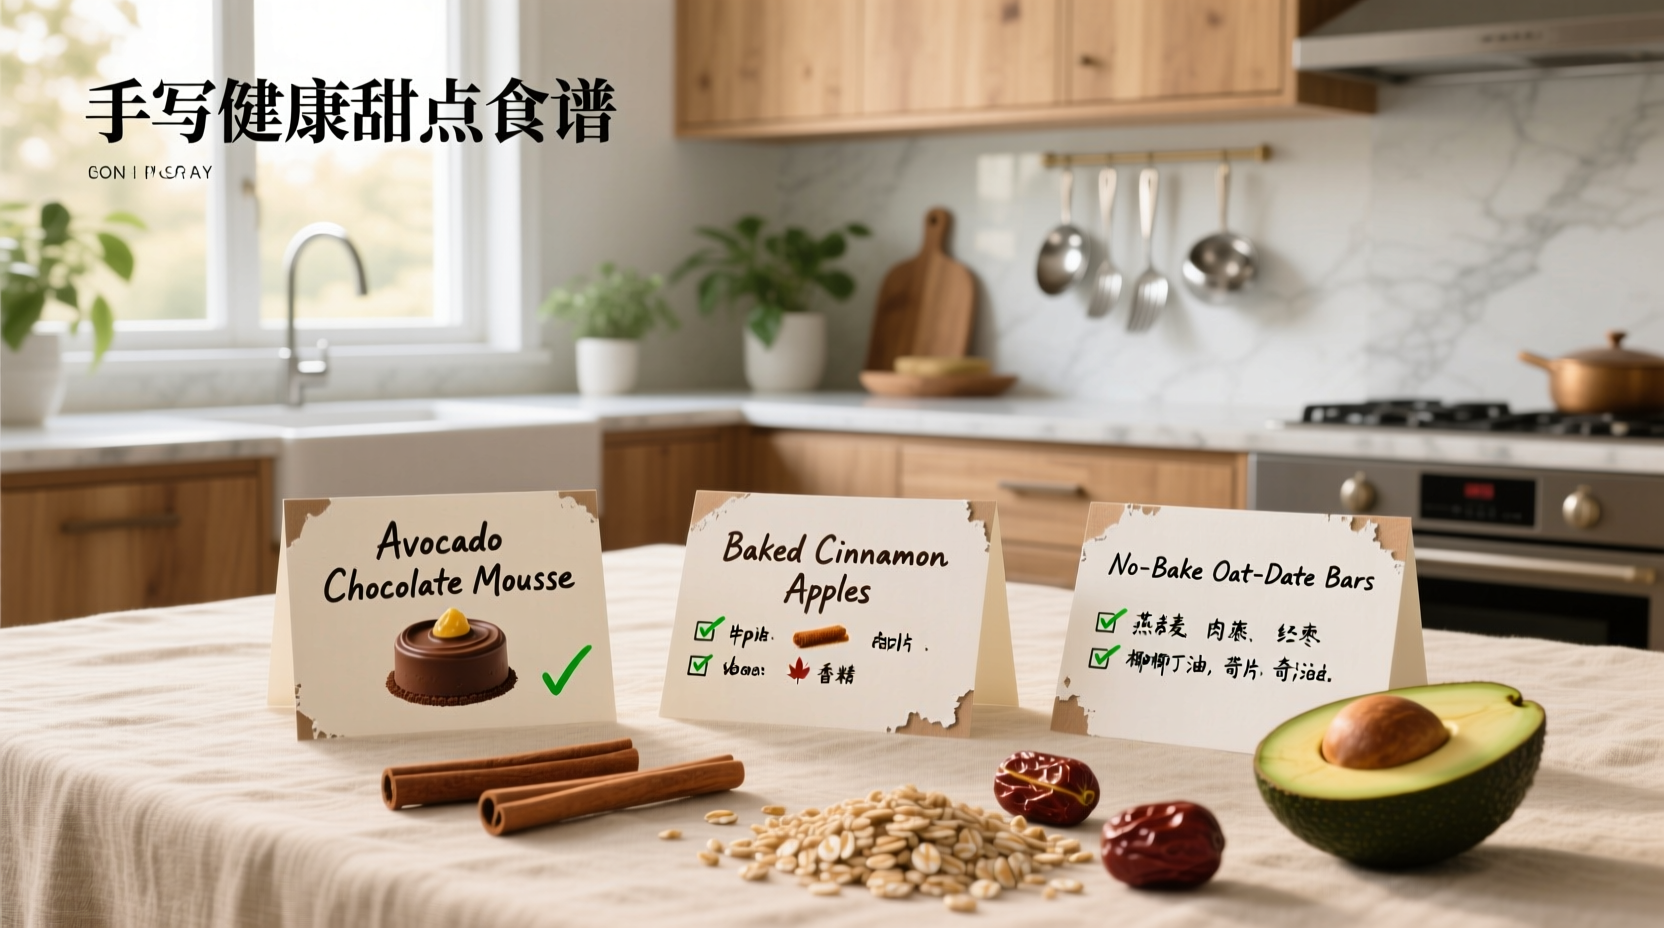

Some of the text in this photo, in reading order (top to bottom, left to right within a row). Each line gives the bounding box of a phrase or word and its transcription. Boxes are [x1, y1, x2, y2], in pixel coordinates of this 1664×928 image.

[375, 520, 503, 561] Avocado
[722, 530, 949, 568] Baked Cinnamon
[323, 562, 576, 604] Chocolate Mousse
[1107, 552, 1376, 591] No-Bake Oat-Date Bars
[783, 572, 872, 615] Apples
[817, 662, 856, 685] 香精
